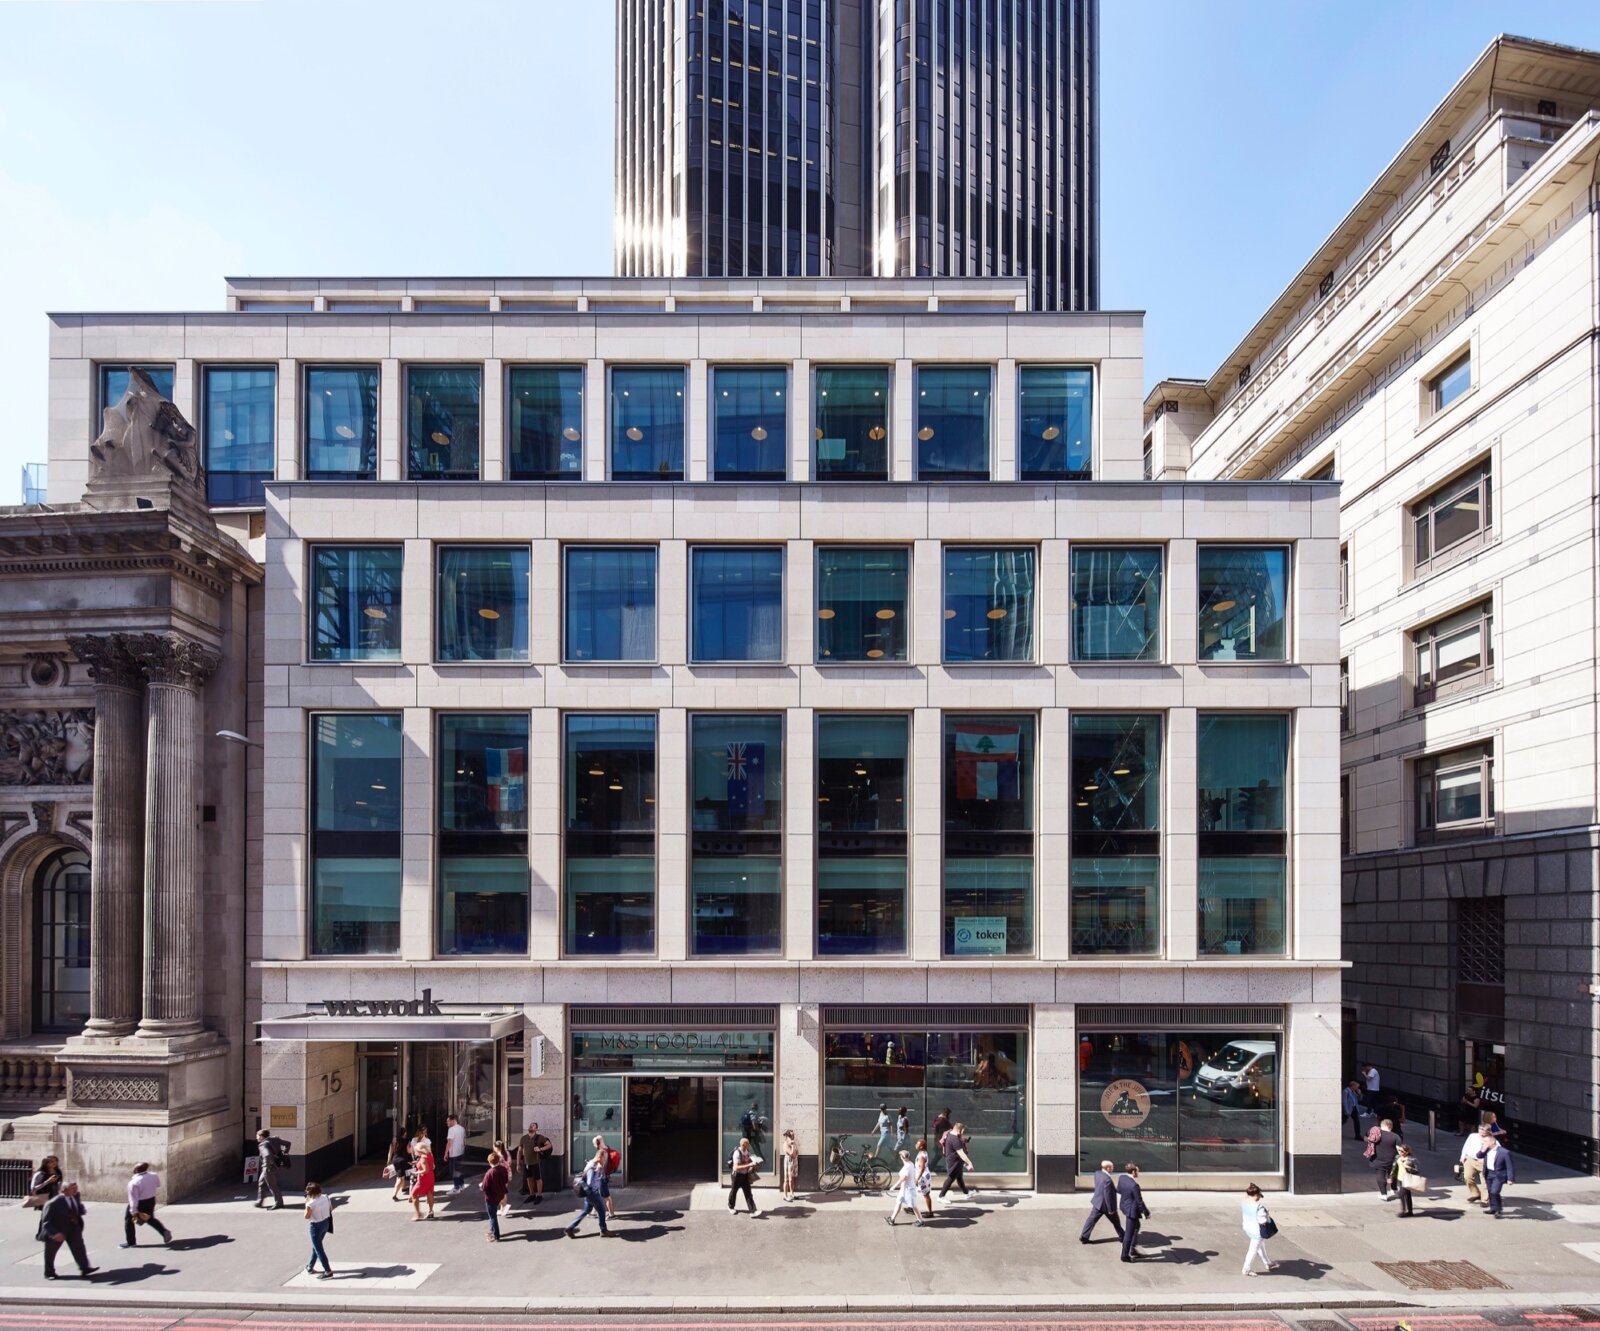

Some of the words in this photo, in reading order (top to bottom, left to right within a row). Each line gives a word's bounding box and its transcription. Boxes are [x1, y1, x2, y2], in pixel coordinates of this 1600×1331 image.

[976, 930, 1005, 940] token
[322, 988, 444, 1017] wework
[601, 1034, 639, 1049] M&S
[646, 1034, 749, 1049] FOODHALL
[321, 1070, 342, 1096] 15
[1119, 1081, 1132, 1089] THE
